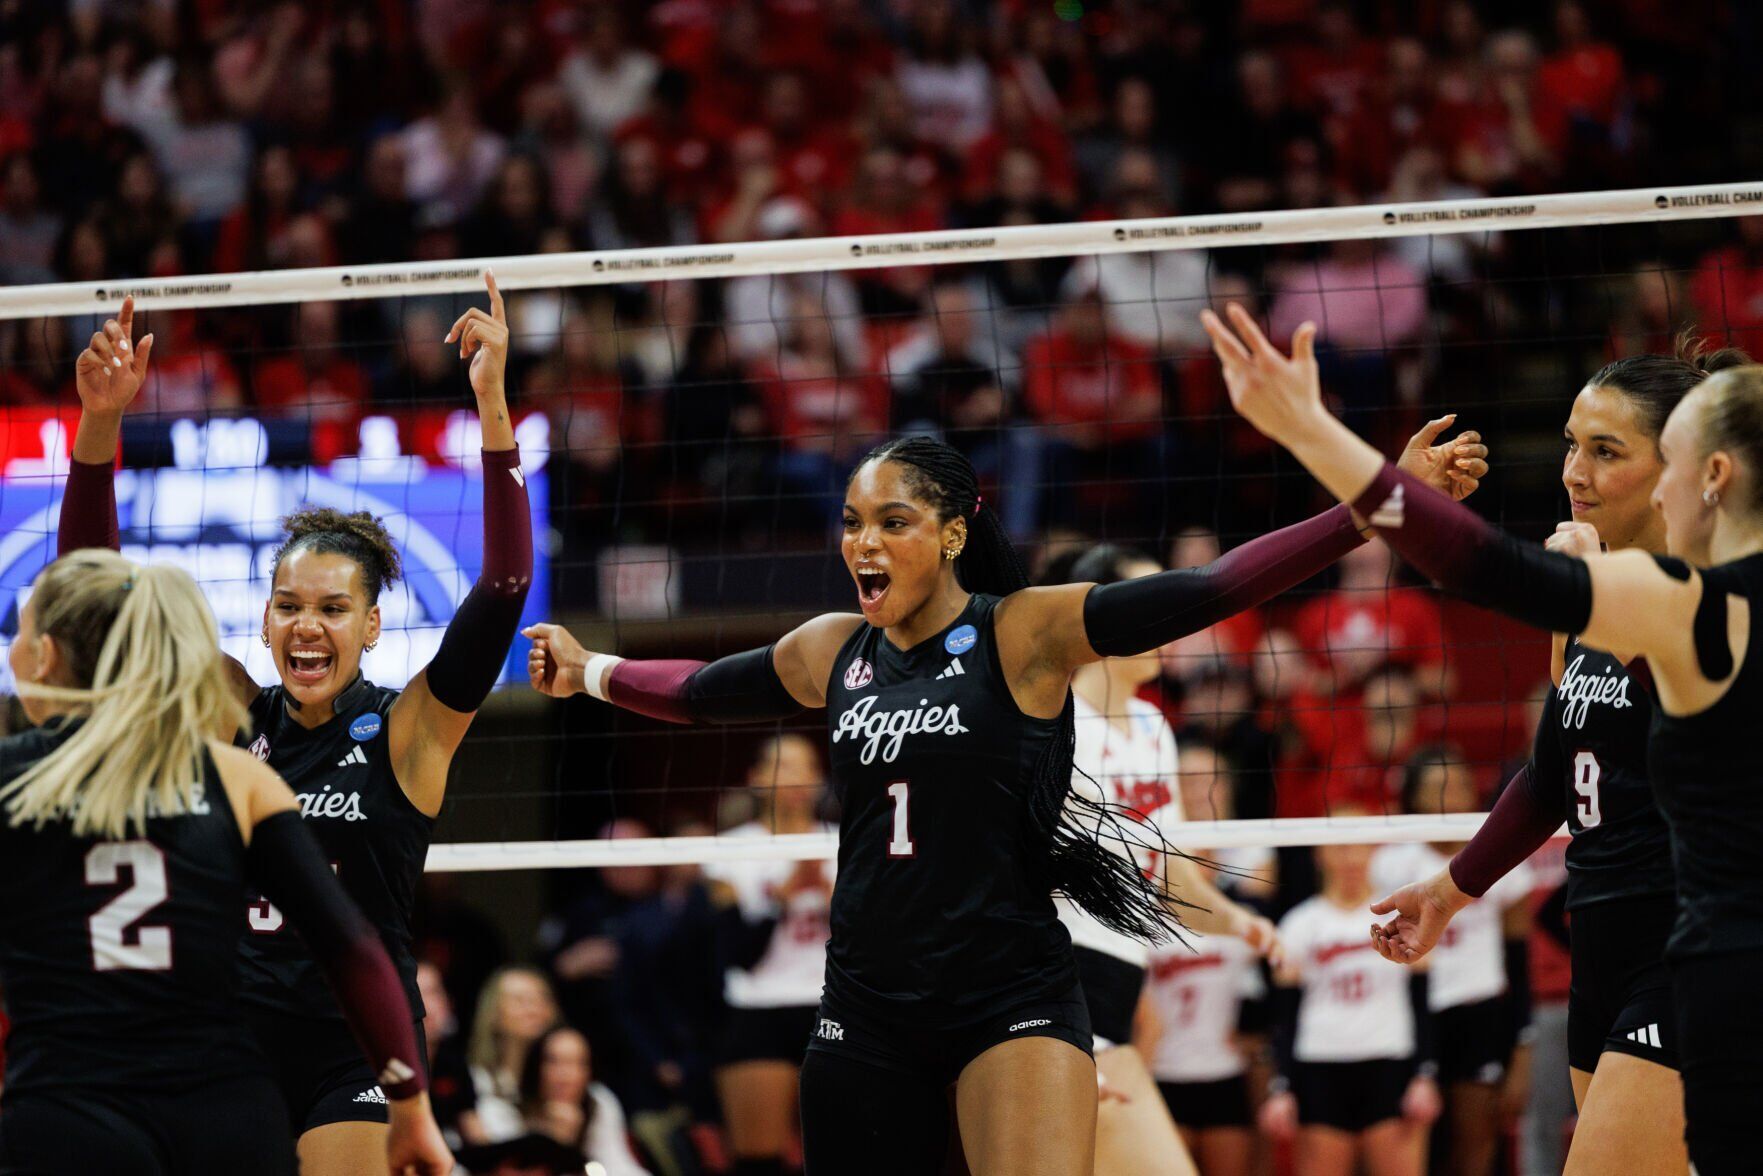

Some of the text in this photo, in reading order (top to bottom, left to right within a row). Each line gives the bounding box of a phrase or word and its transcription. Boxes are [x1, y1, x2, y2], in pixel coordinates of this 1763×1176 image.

[1671, 193, 1730, 207] VOLLEYBALL
[1399, 205, 1536, 223] VOLLEYBALL CHAMPIONSHIP
[1129, 222, 1262, 239] VOLLEYBALL CHAMPIONSHIP
[864, 238, 995, 256] VOLLEYBALL CHAMPIONSHIP
[607, 253, 734, 270] VOLLEYBALL CHAMPIONSHIP
[355, 269, 480, 286] VOLLEYBALL CHAMPIONSHIP
[163, 283, 232, 297] CHAMPIONSHIP
[845, 659, 872, 690] SEC
[1557, 654, 1632, 730] Aggies
[832, 695, 970, 766] Aggies
[1573, 751, 1602, 828] 9
[887, 782, 914, 856] 1
[85, 842, 171, 971] 2
